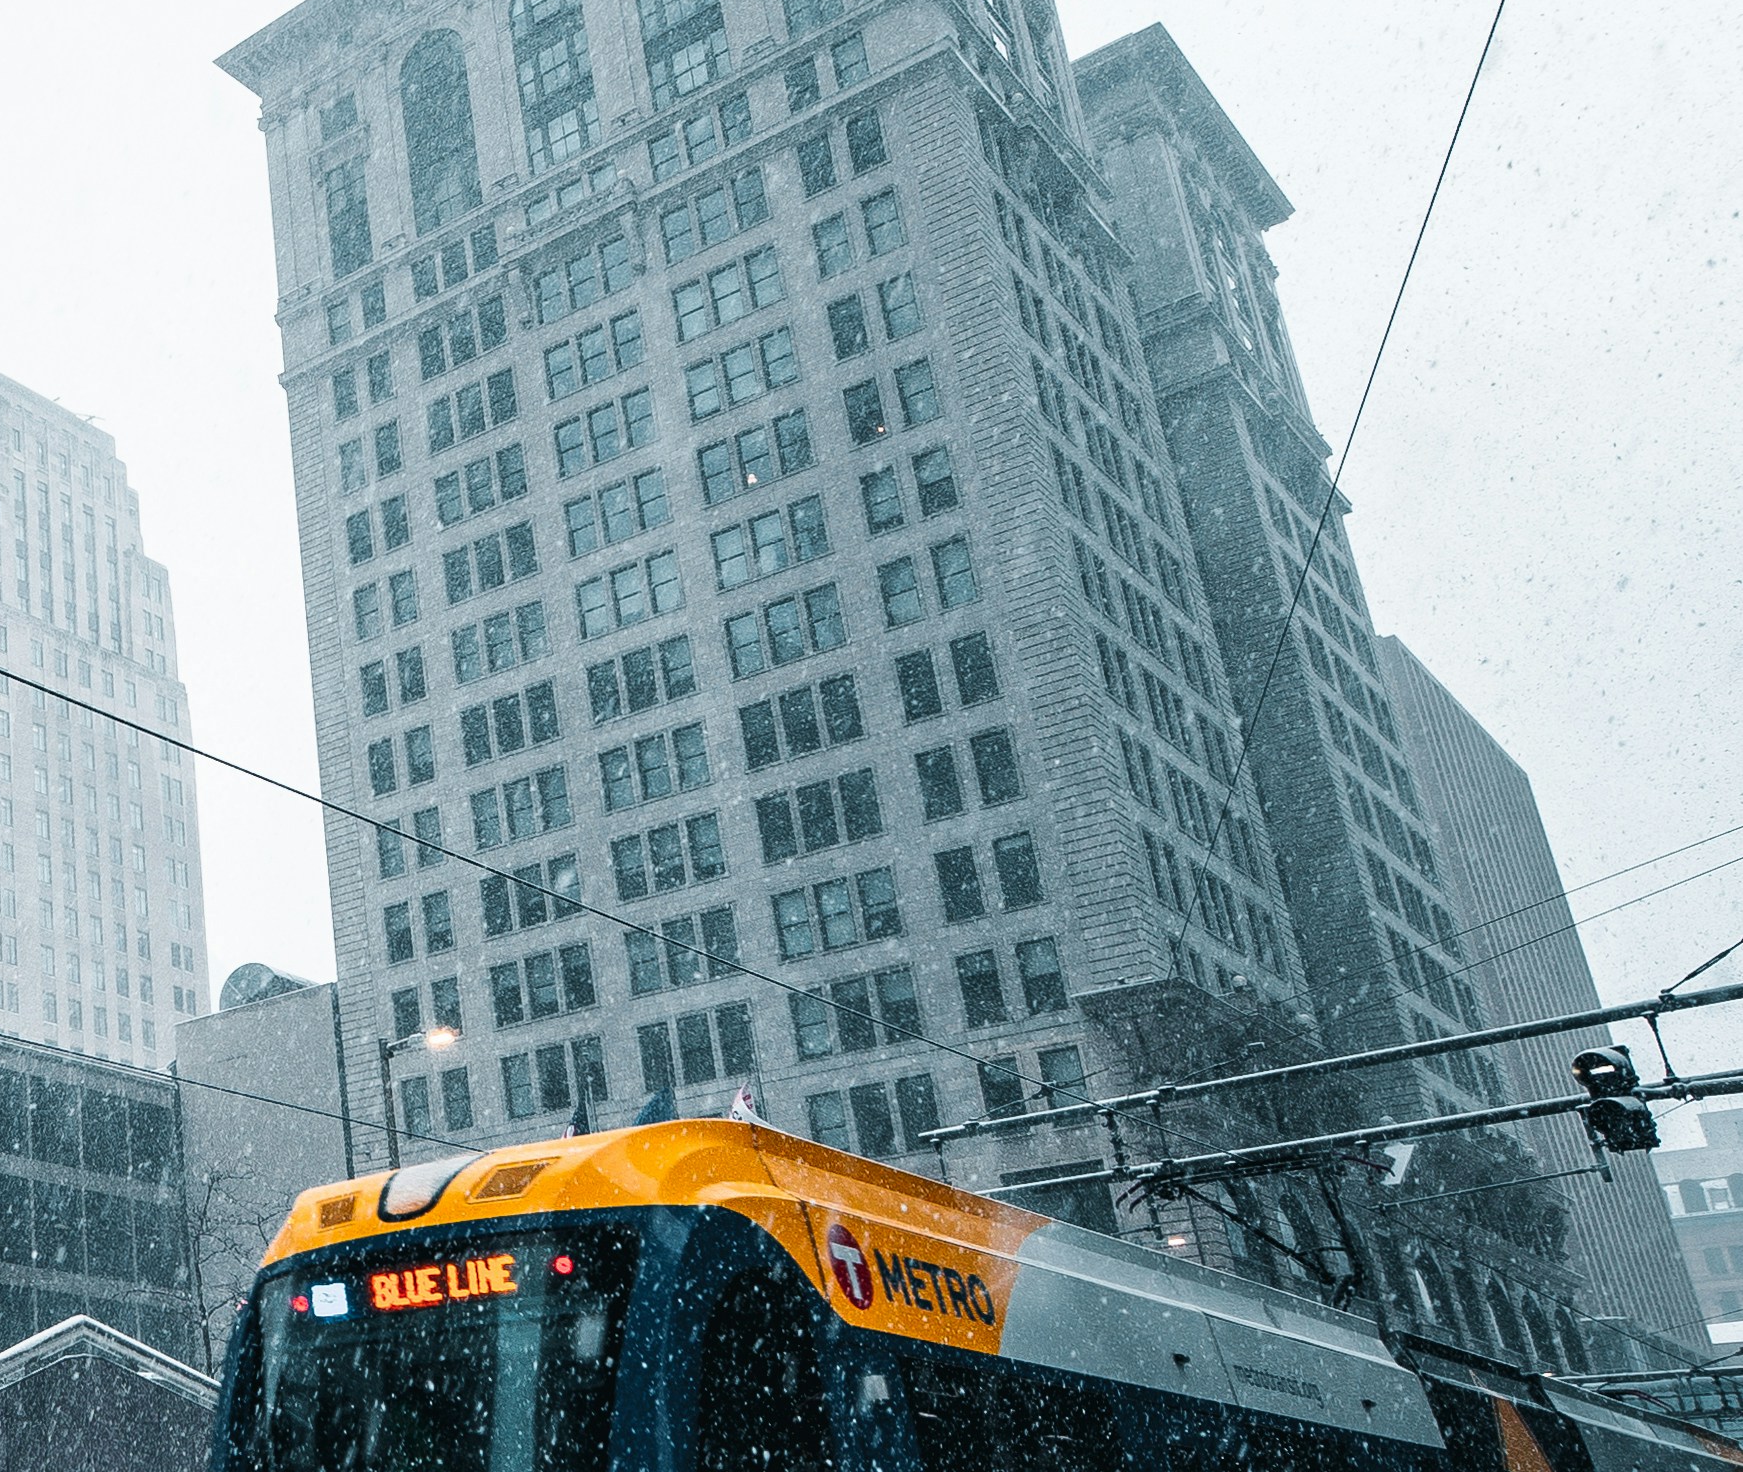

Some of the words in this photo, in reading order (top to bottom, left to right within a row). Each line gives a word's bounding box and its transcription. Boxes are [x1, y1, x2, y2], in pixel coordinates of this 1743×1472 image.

[370, 1265, 443, 1310] BLUE
[446, 1253, 519, 1299] LINE
[873, 1248, 996, 1327] METRO
